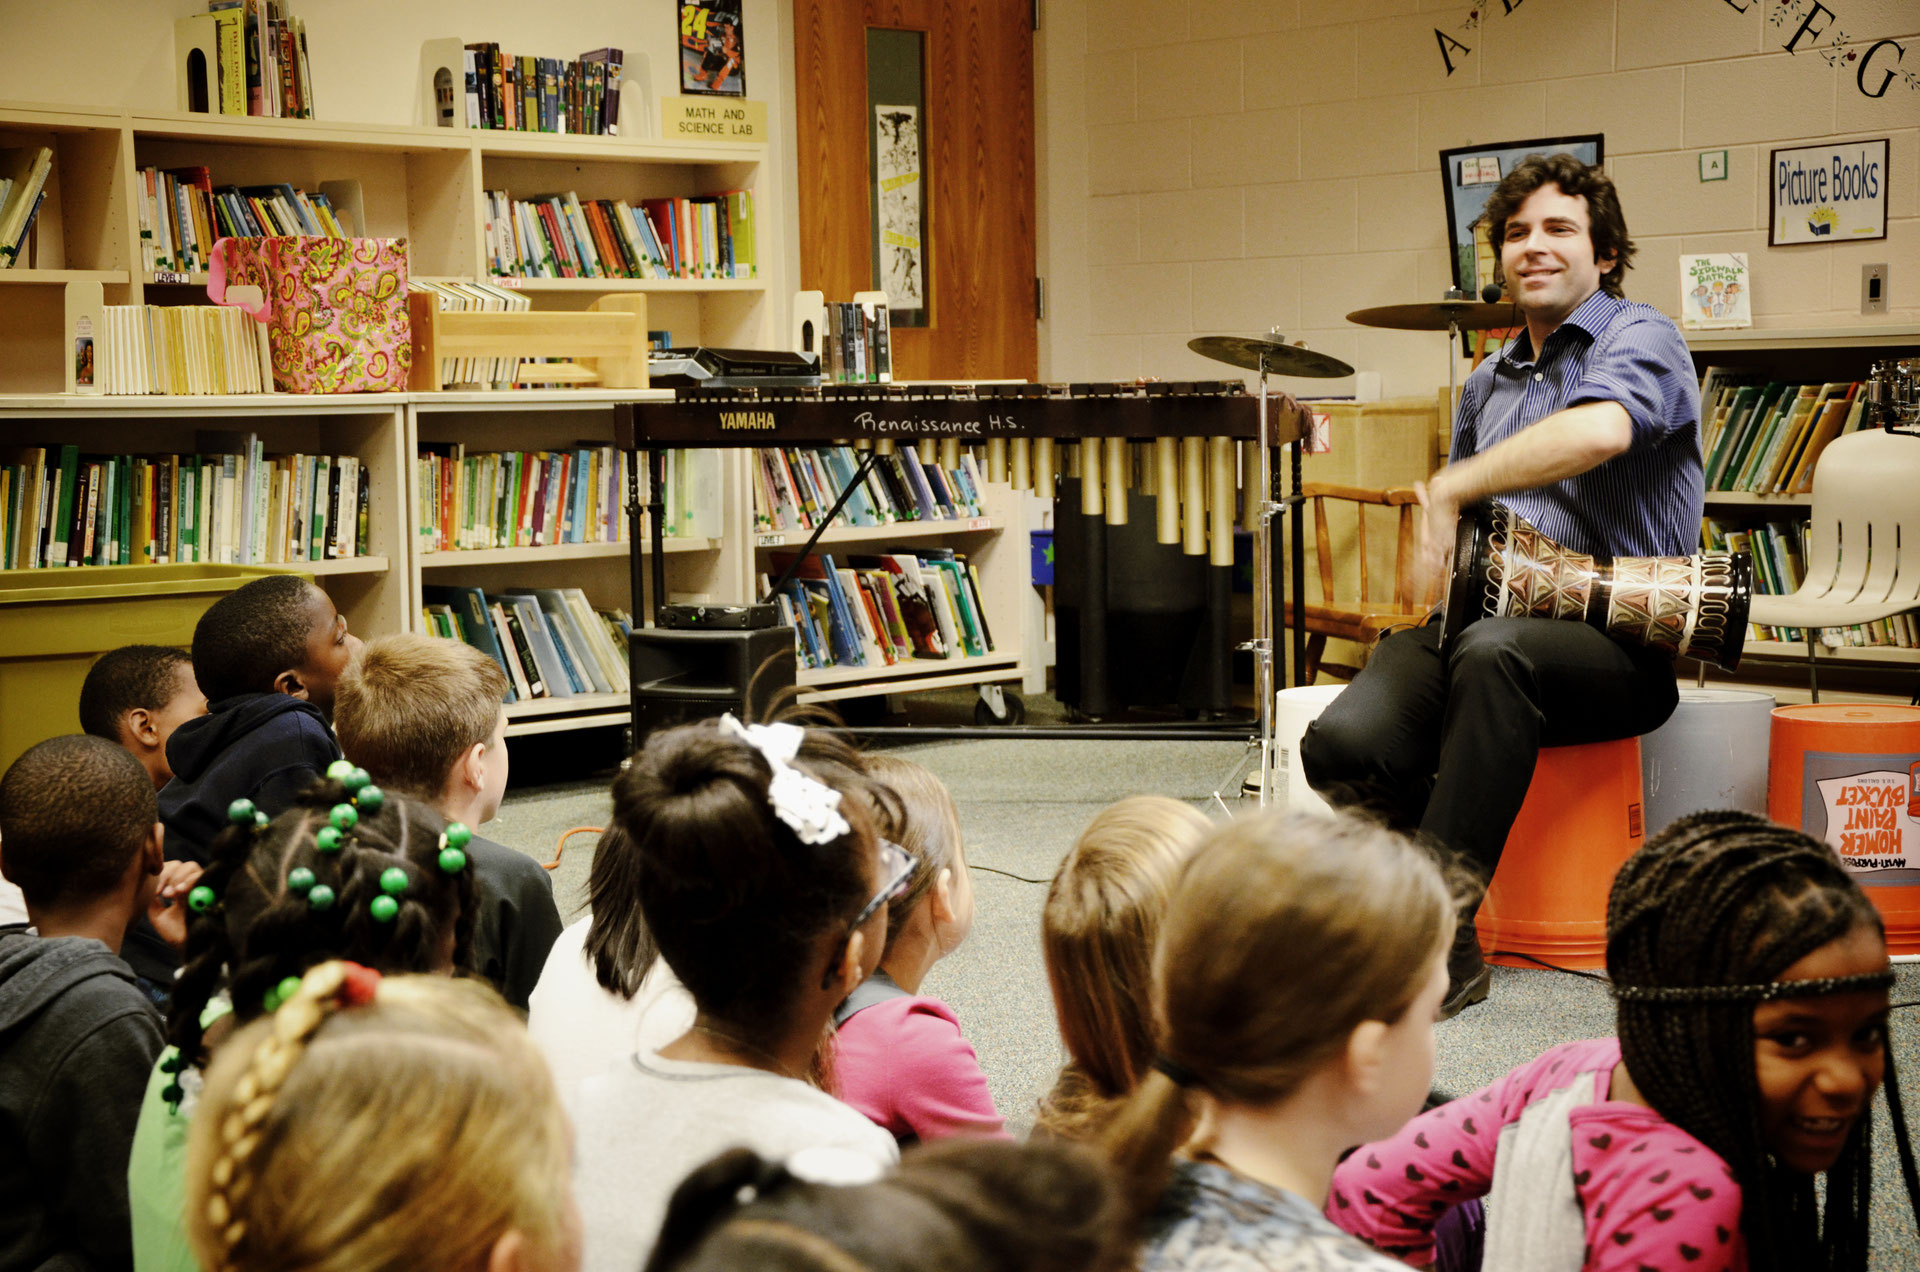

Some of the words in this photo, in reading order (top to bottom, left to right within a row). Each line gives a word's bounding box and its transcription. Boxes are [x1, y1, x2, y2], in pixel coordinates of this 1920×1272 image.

[681, 4, 709, 39] 24
[1434, 28, 1471, 77] A
[1782, 0, 1836, 56] F
[1857, 40, 1906, 98] G
[685, 107, 715, 118] MATH
[723, 109, 745, 120] AND
[679, 121, 724, 134] SCIENCE
[732, 124, 753, 135] LAB
[1711, 160, 1718, 169] A
[1779, 160, 1827, 206] Picture
[1833, 151, 1878, 202] Books
[1689, 266, 1743, 276] SIDEWALK
[1695, 258, 1711, 267] THE
[158, 273, 176, 283] LEVEL
[1698, 273, 1738, 284] PATROL
[719, 412, 776, 429] YAMAHA
[854, 412, 981, 434] Renaissance
[989, 415, 1025, 430] H.S.
[1836, 785, 1905, 808] BUCKET
[1844, 807, 1897, 830] PAINT
[1840, 829, 1902, 856] HOMER
